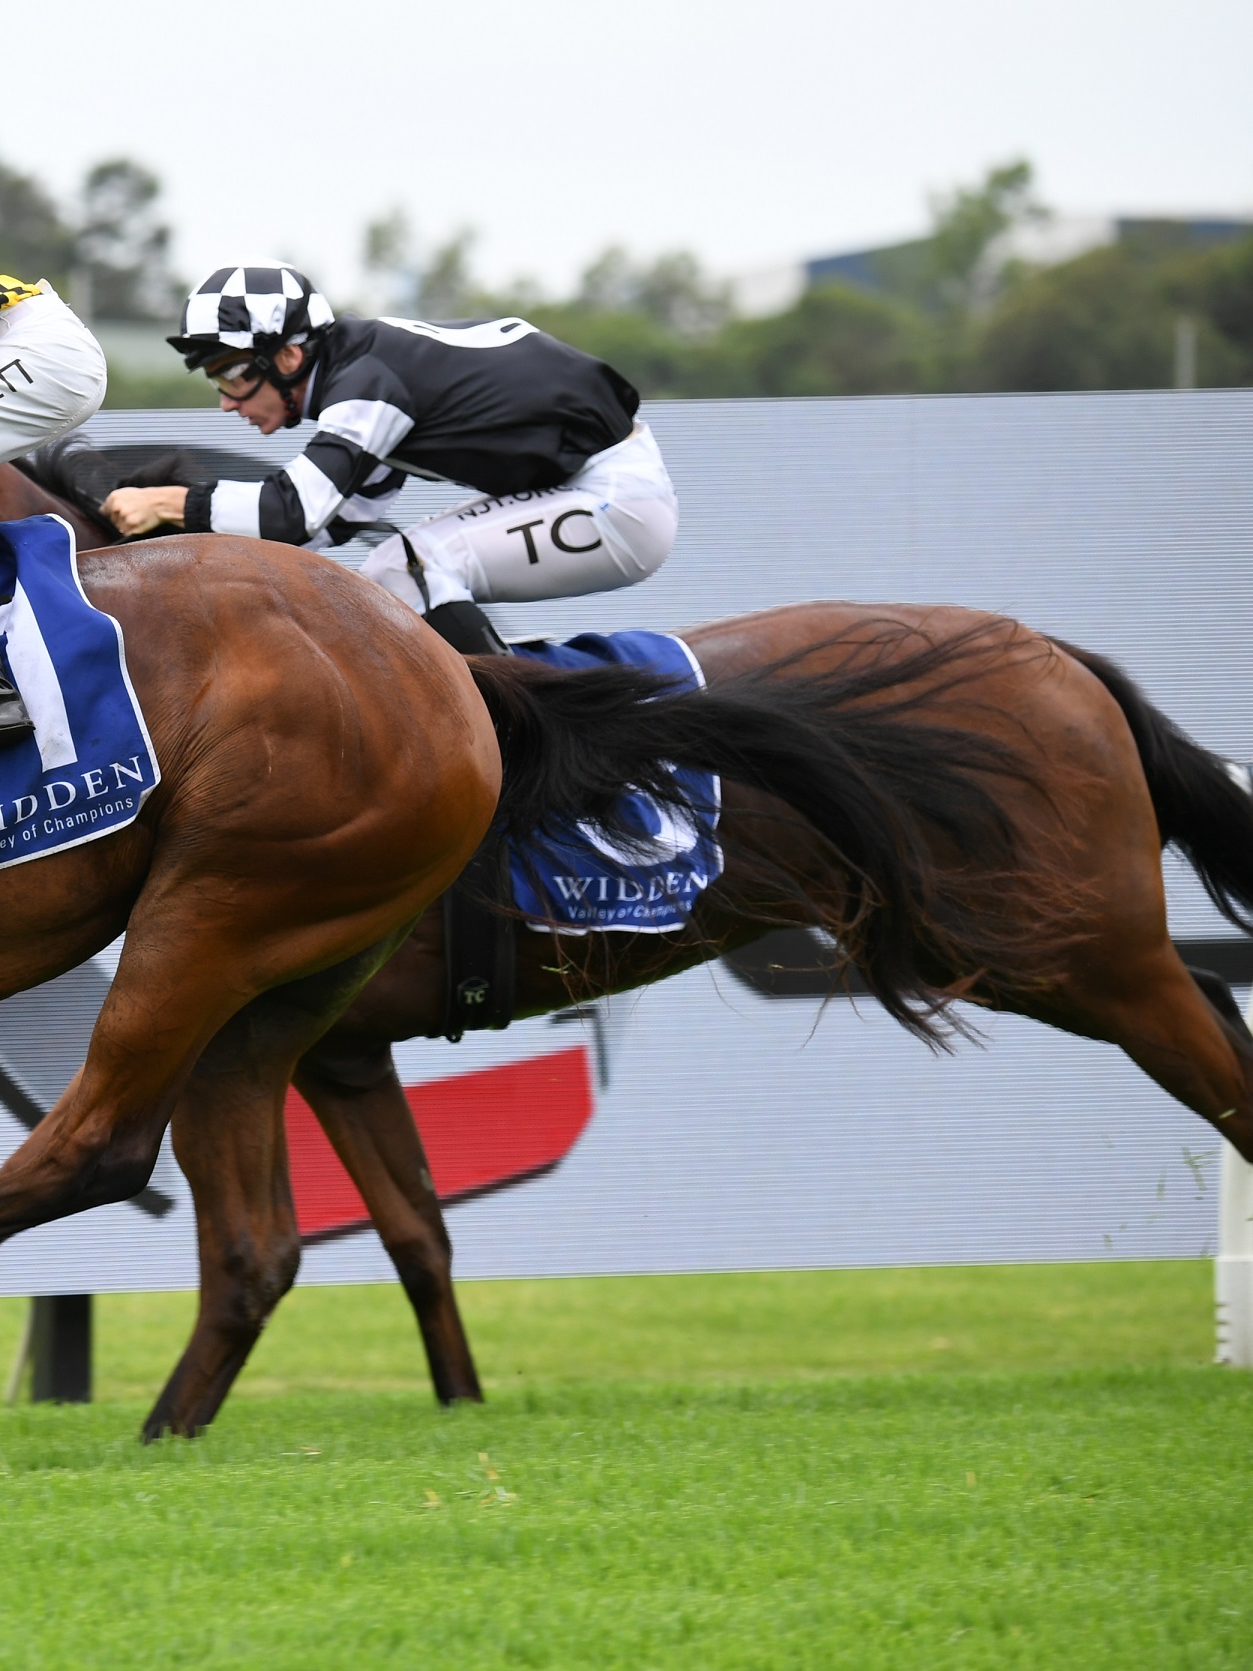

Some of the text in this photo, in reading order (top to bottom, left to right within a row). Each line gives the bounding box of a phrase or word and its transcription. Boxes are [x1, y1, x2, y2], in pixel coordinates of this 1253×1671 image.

[506, 509, 602, 565] TC
[22, 823, 38, 841] of
[43, 797, 134, 835] Champions
[553, 871, 708, 902] WIDDEN
[464, 990, 485, 1004] TC
